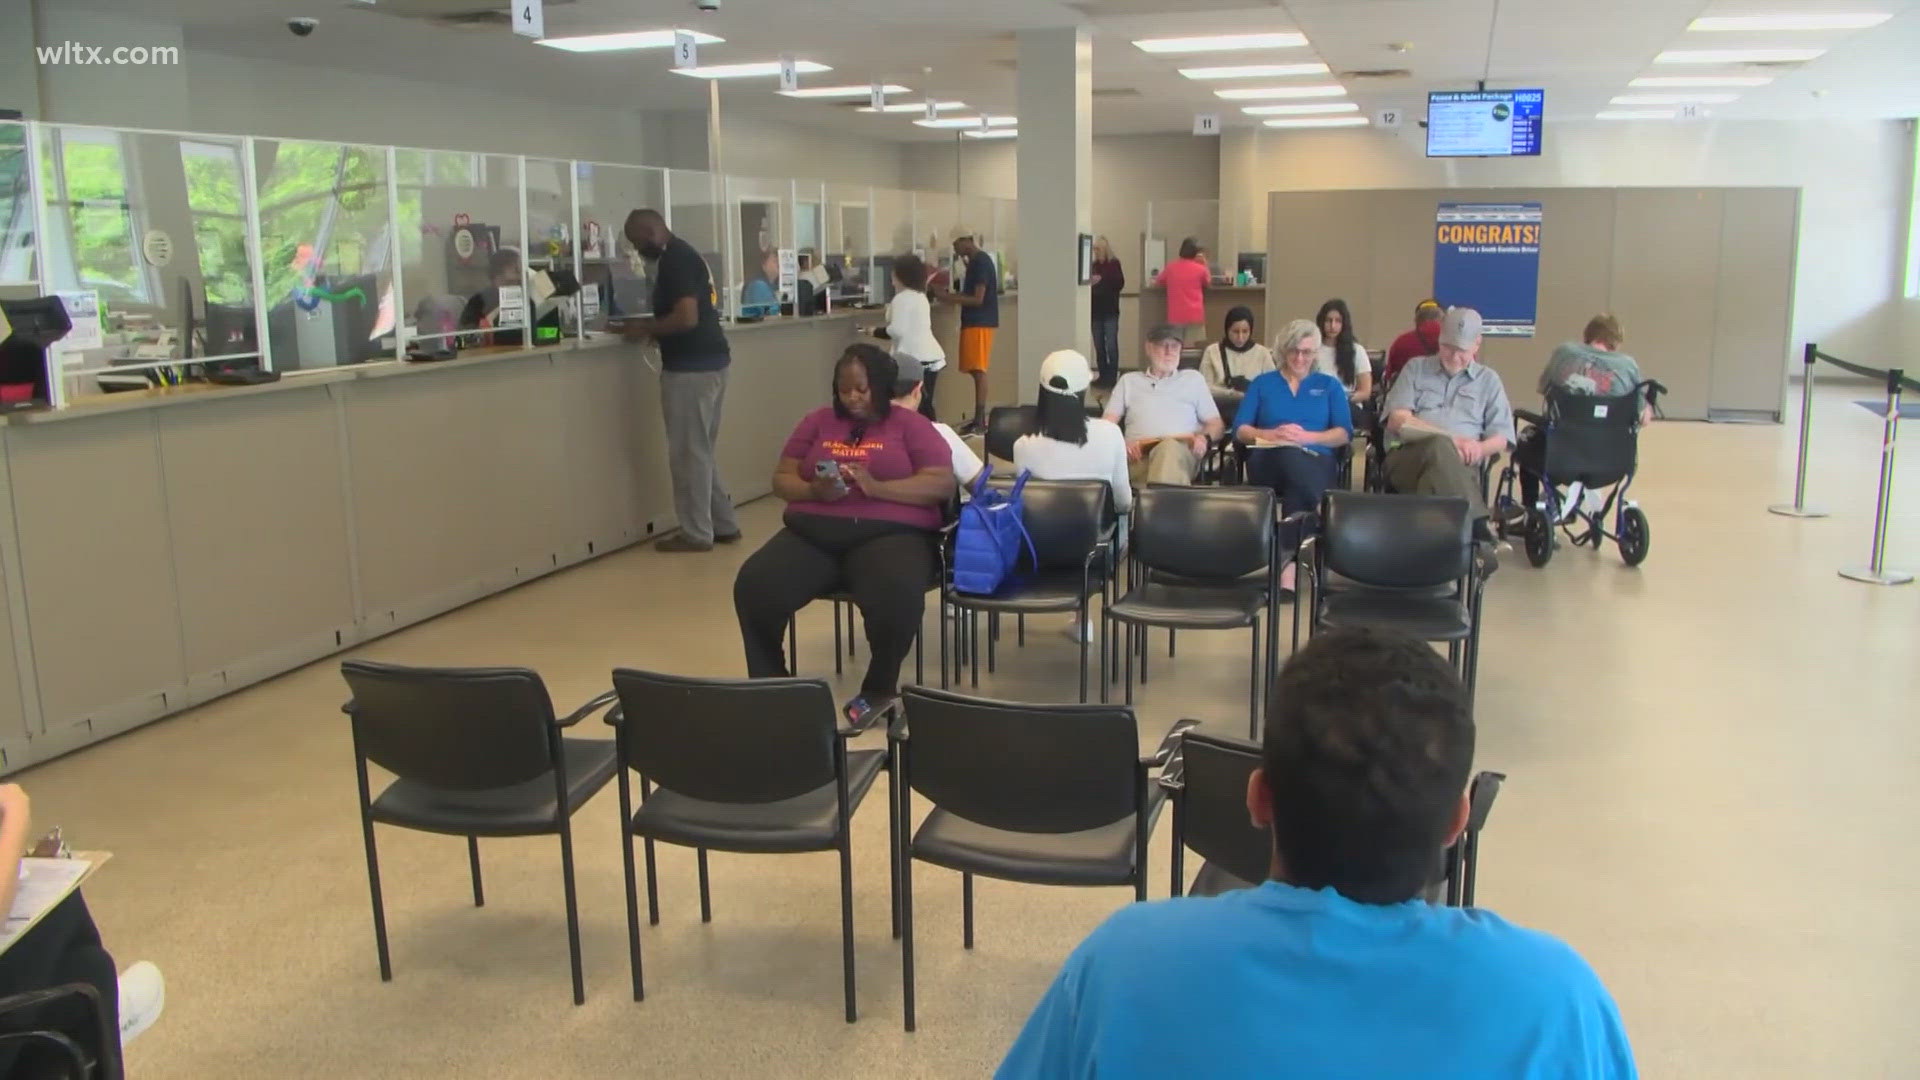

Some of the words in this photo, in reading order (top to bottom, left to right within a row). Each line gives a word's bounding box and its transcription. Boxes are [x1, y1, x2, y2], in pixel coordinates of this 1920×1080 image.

[523, 5, 532, 24] 4
[682, 42, 689, 60] 5
[1203, 118, 1212, 129] 11
[1384, 112, 1395, 124] 12
[1437, 223, 1541, 245] CONGRATS!
